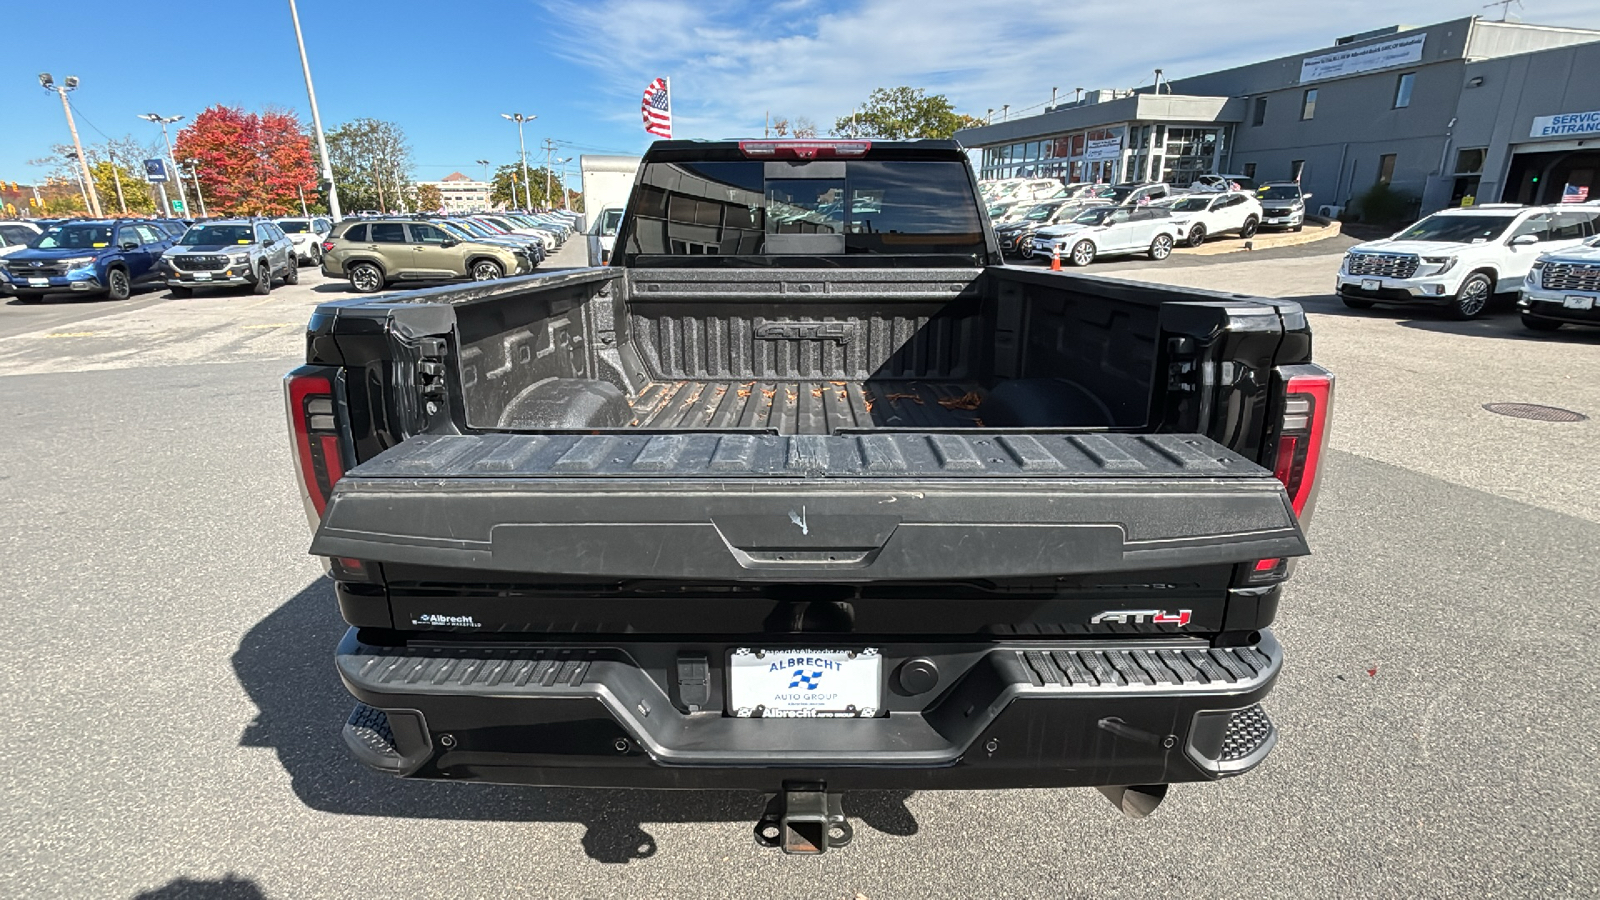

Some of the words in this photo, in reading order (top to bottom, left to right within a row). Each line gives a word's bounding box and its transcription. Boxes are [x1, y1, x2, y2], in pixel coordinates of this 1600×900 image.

[1552, 113, 1600, 125] SERVIC
[430, 614, 473, 623] Albrecht
[1091, 610, 1192, 627] AT4
[769, 657, 842, 672] ALBRECHT
[774, 693, 801, 701] AUTO
[803, 693, 838, 701] GROUP
[762, 707, 816, 718] Albrecht
